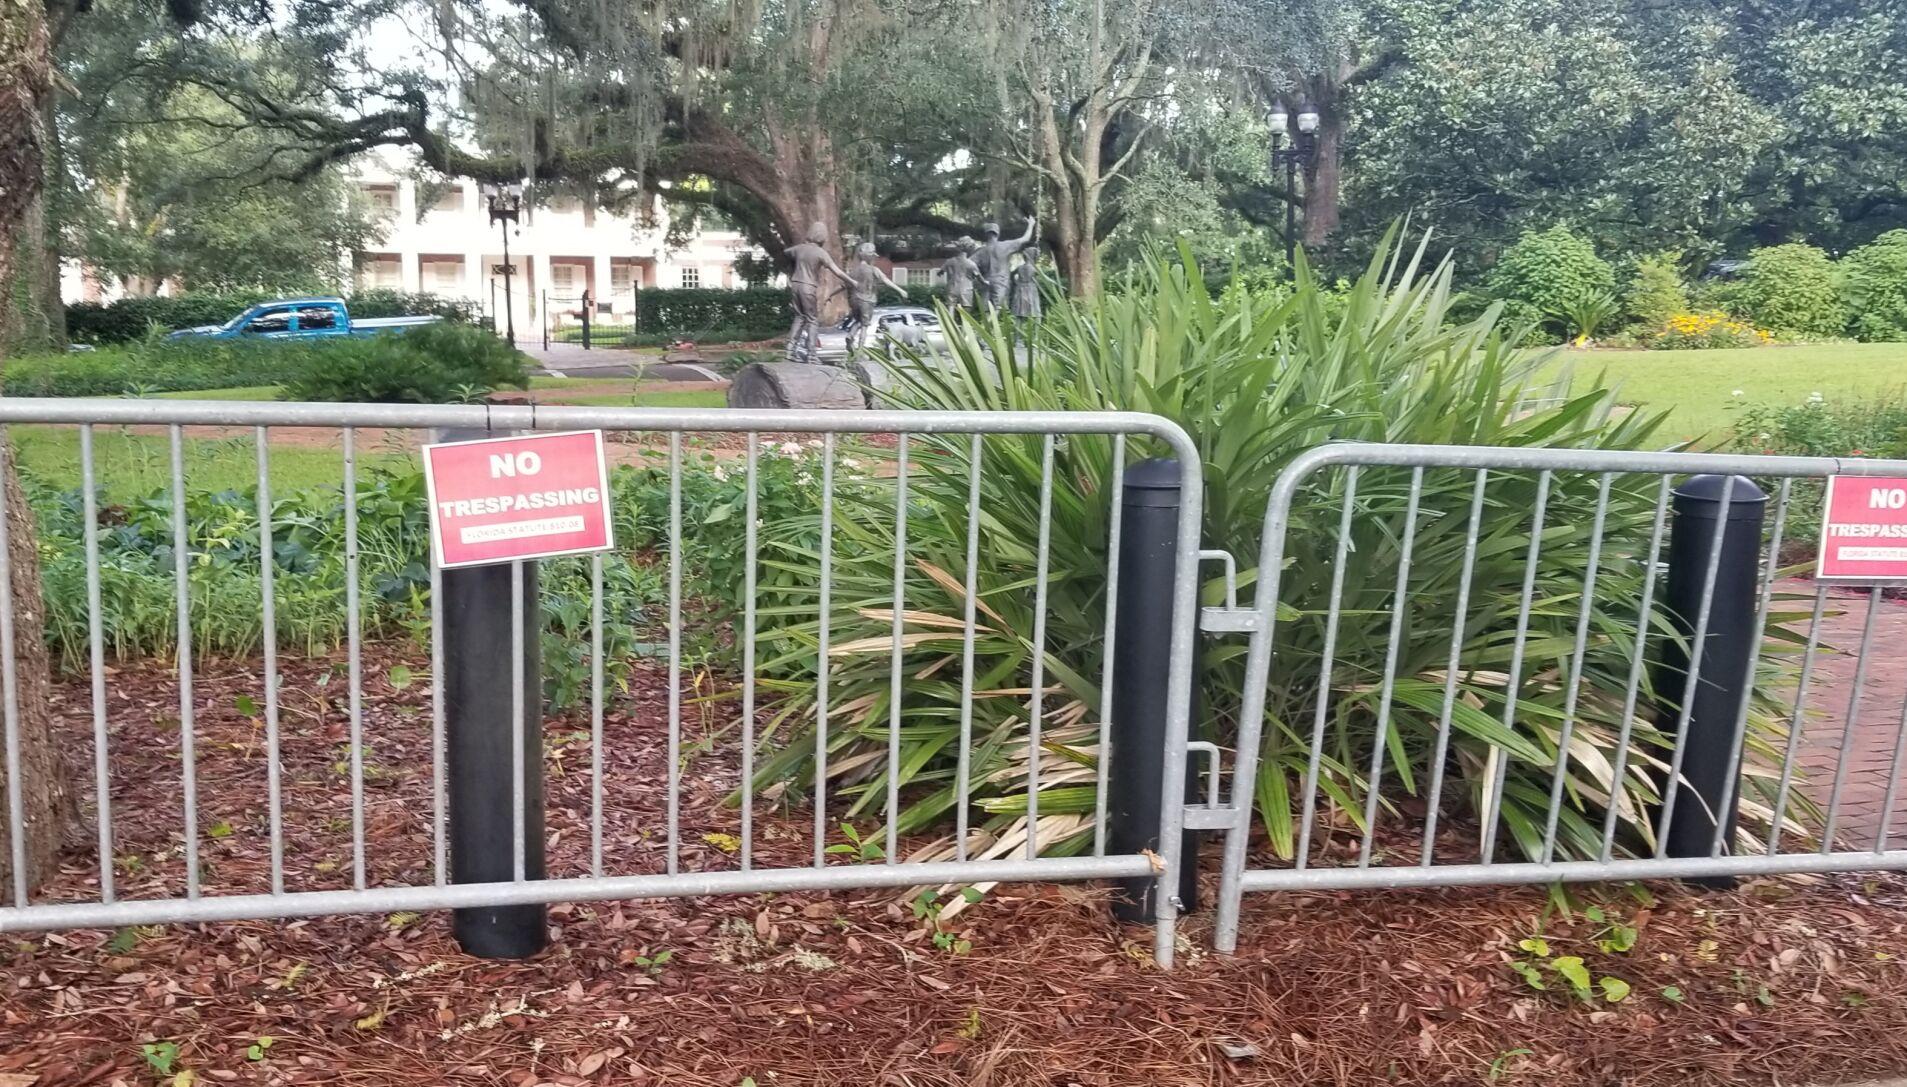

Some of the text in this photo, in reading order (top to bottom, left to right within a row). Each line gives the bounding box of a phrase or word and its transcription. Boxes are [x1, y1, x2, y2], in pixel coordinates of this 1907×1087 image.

[489, 451, 542, 478] NO
[439, 487, 600, 518] TRESPASSING
[1869, 488, 1906, 509] NO
